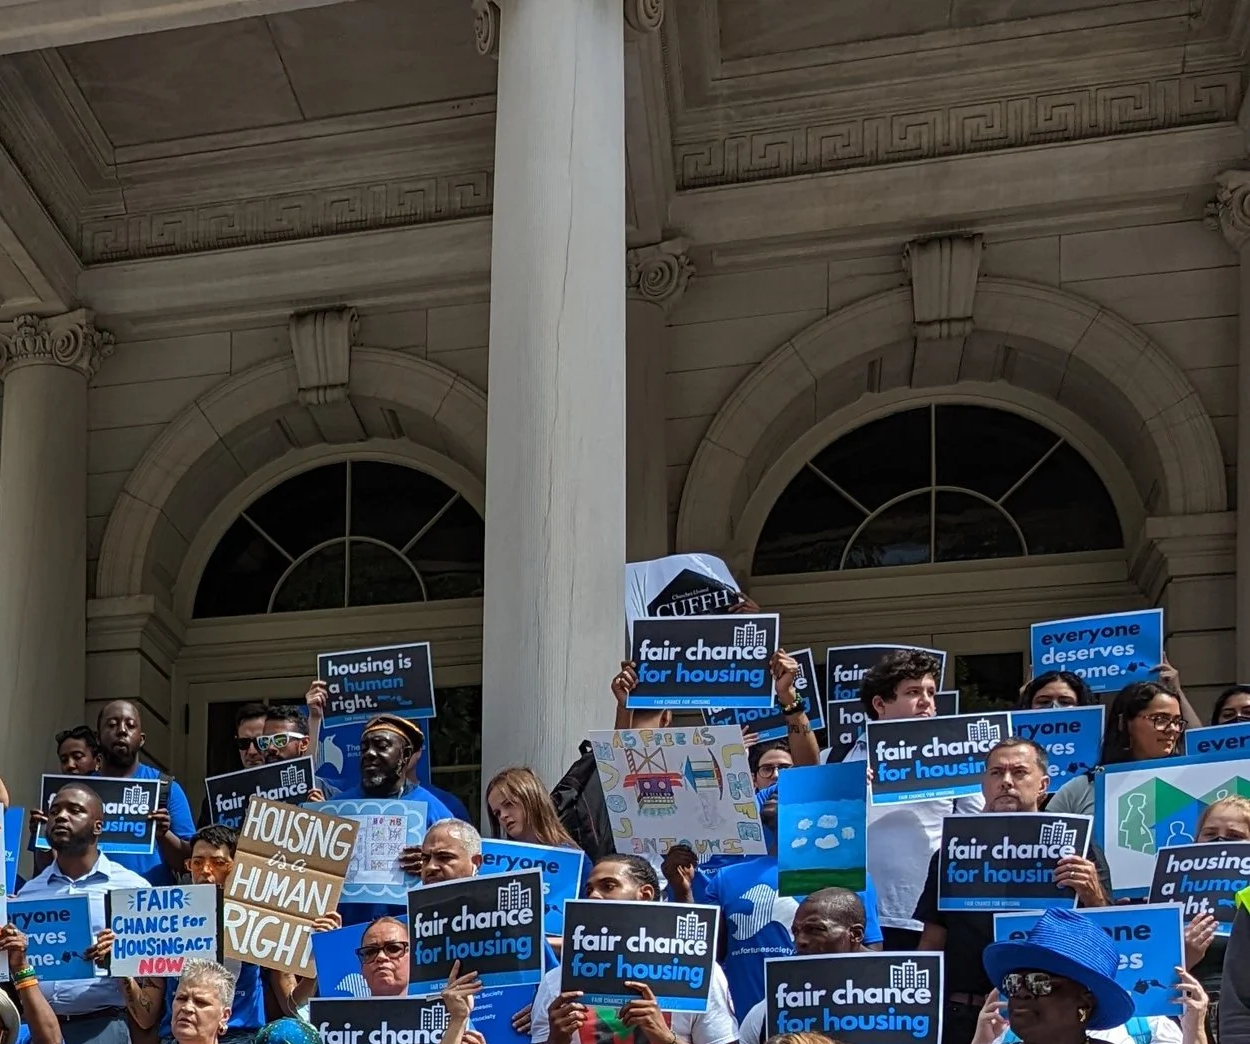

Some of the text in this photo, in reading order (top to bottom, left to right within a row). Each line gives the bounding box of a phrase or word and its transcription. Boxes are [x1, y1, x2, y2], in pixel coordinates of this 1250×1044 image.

[656, 589, 731, 617] CUFFH
[1041, 622, 1141, 646] everyone
[640, 638, 768, 661] fair chance
[1041, 643, 1135, 665] deserves
[327, 654, 412, 677] housing is
[638, 663, 765, 688] for housing
[329, 676, 403, 694] a human
[332, 695, 378, 714] right.
[692, 728, 716, 746] AS
[876, 741, 917, 761] fair
[878, 757, 986, 782] for housin
[216, 794, 245, 813] fair
[948, 832, 1077, 860] fair chance
[267, 850, 308, 874] is a
[483, 852, 560, 875] eryone
[947, 860, 1054, 885] for housin
[1166, 851, 1250, 875] housing
[230, 864, 332, 916] HUMAN
[1161, 874, 1249, 896] a huma
[136, 890, 184, 912] FAIR
[112, 916, 178, 935] CHANCE
[414, 905, 534, 939] fair chance
[186, 938, 213, 951] ACT
[224, 903, 316, 969] RIGHT
[572, 925, 707, 957] fair chance
[416, 931, 532, 966] for housing
[138, 957, 184, 976] NOW
[572, 954, 705, 989] for housing
[775, 980, 932, 1008] fair chance
[372, 1022, 444, 1044] chanc
[776, 1008, 930, 1038] for housing
